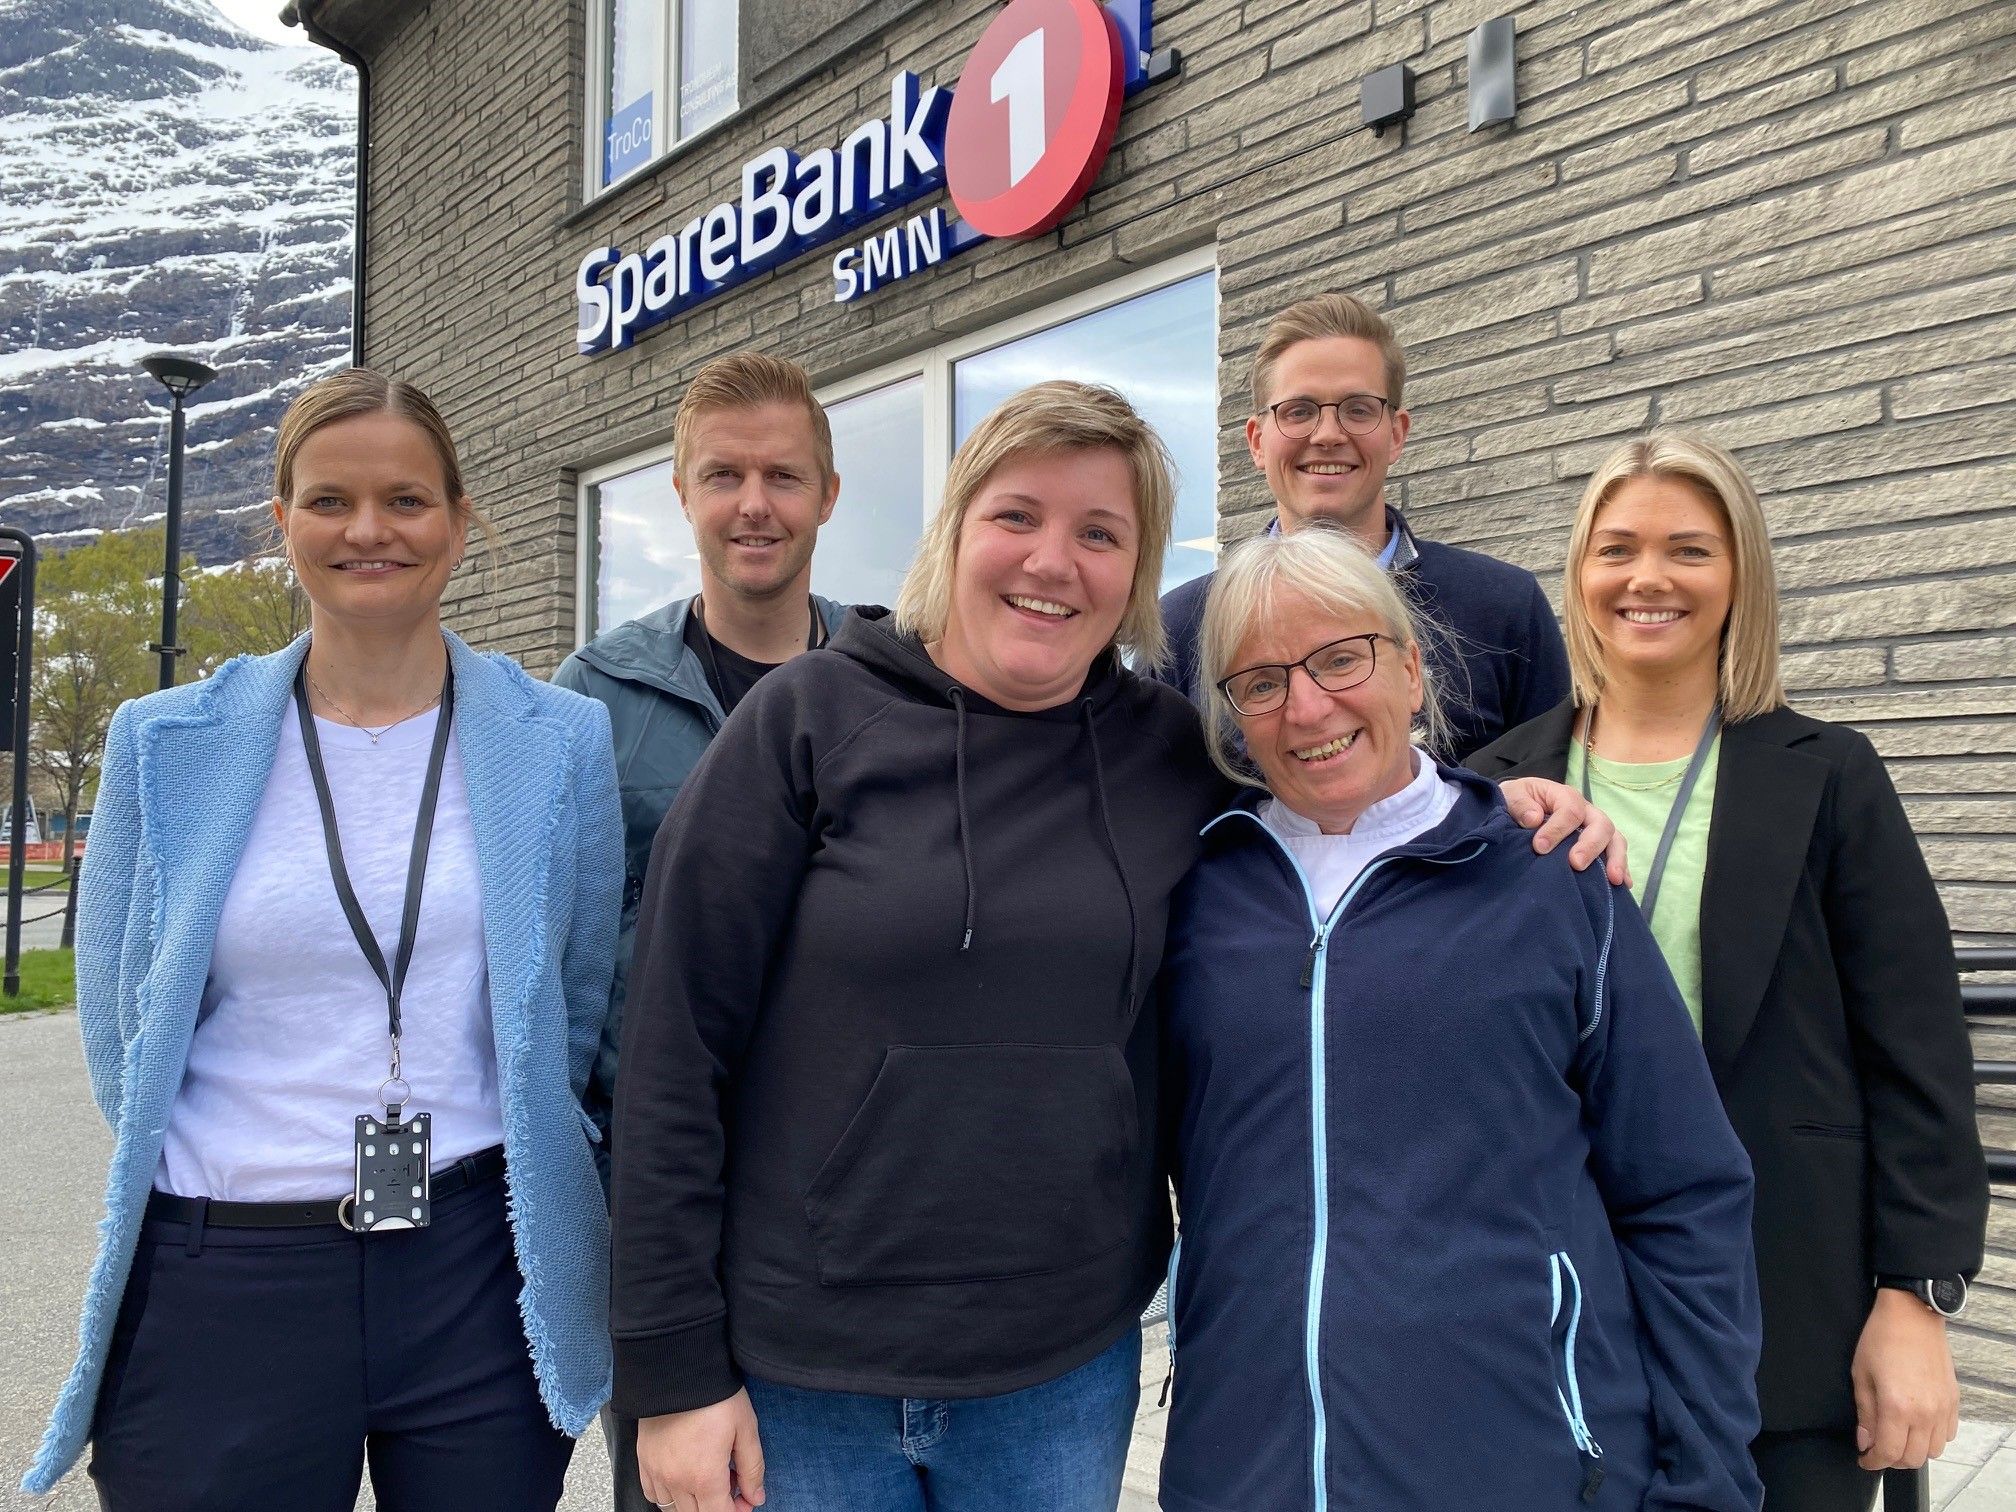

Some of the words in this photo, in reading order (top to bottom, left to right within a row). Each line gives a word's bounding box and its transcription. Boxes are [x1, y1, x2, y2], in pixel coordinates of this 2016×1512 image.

[608, 117, 651, 163] TroCo
[576, 70, 939, 349] SpareBank
[990, 27, 1045, 188] 1
[834, 208, 942, 302] SMN
